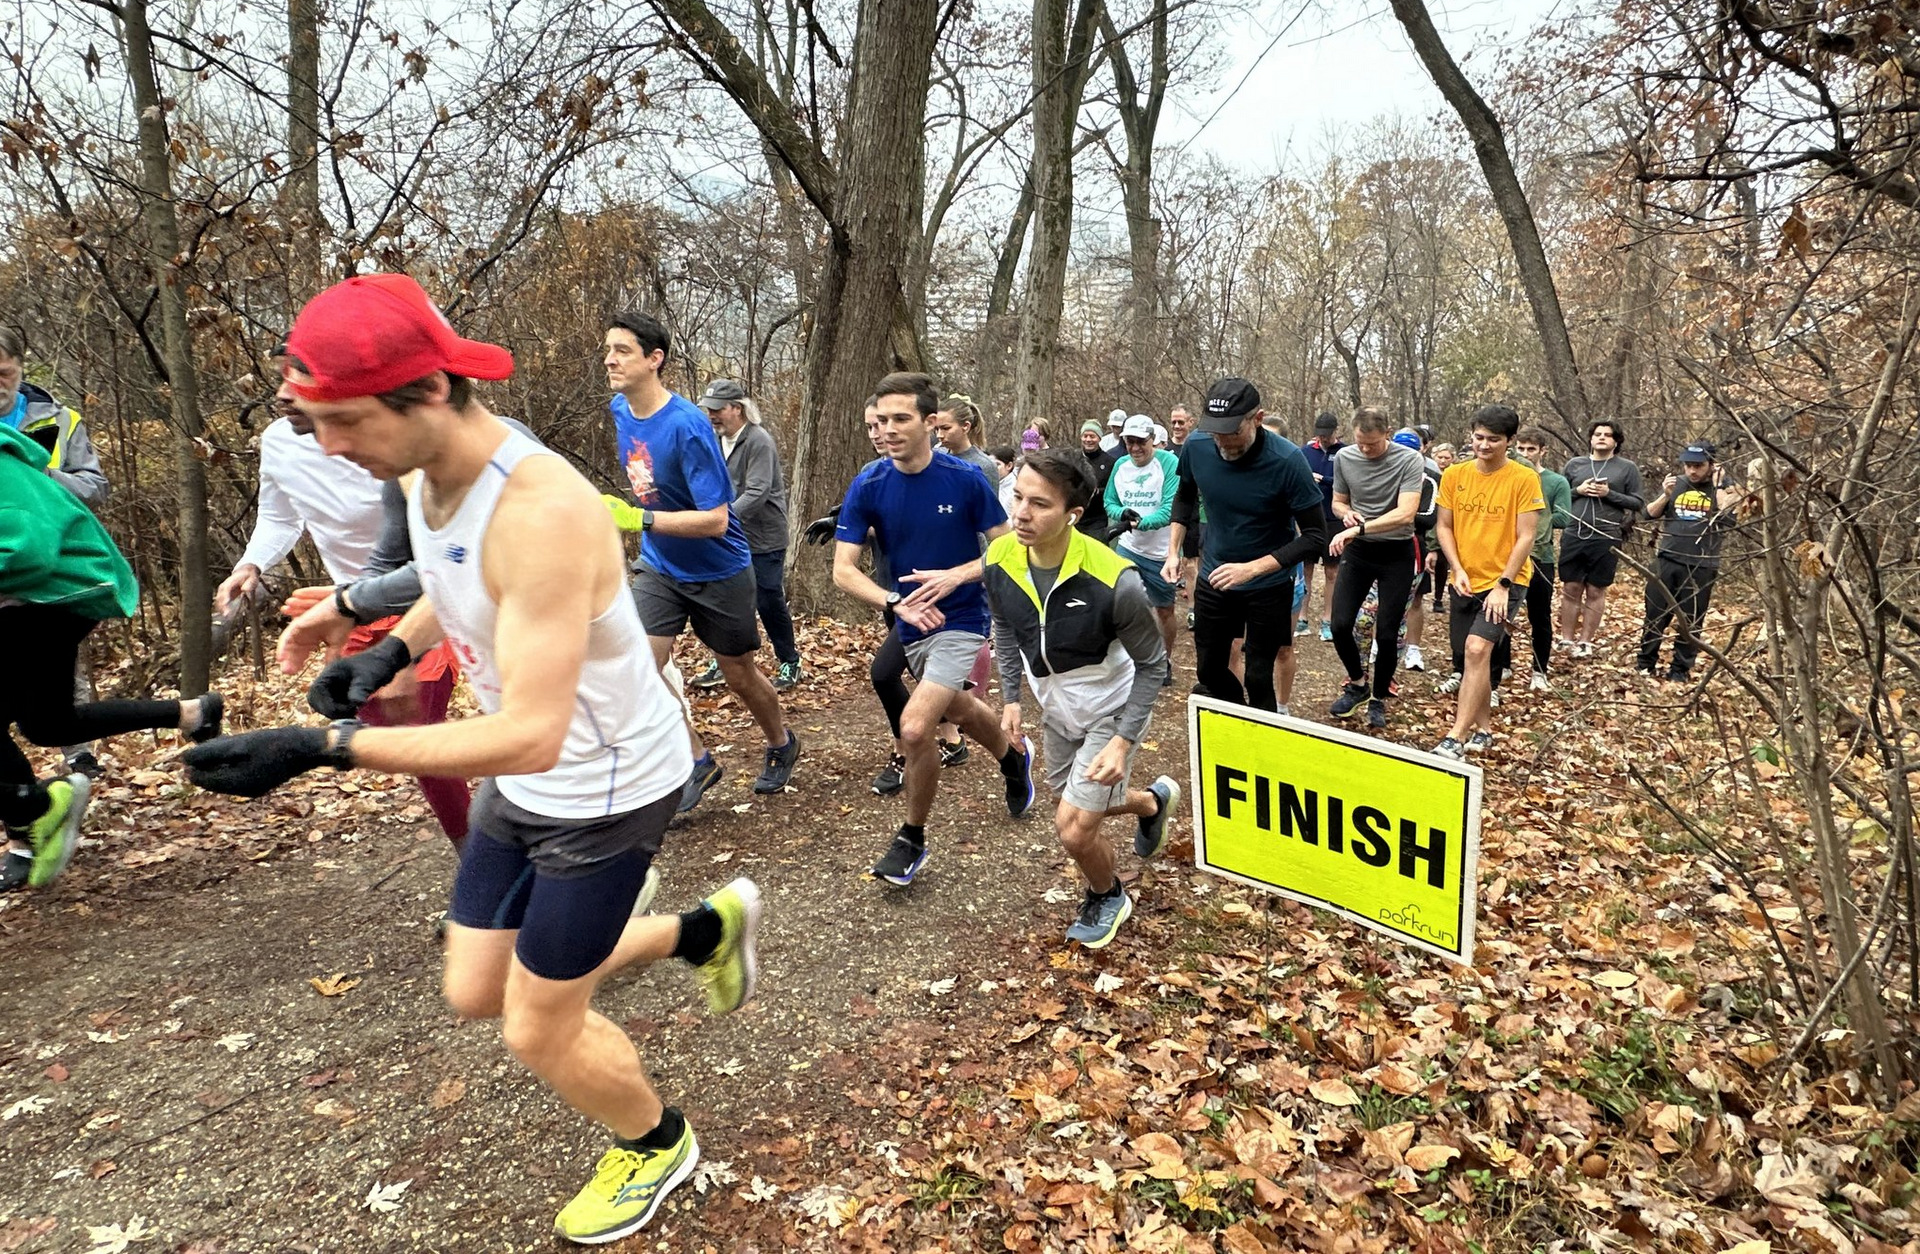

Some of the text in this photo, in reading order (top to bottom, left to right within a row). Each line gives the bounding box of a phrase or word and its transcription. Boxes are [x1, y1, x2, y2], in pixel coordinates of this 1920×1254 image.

[1122, 499, 1158, 508] Striders
[1123, 489, 1157, 499] Sydney
[1215, 764, 1447, 890] FINISH
[1378, 903, 1455, 945] parkrun
